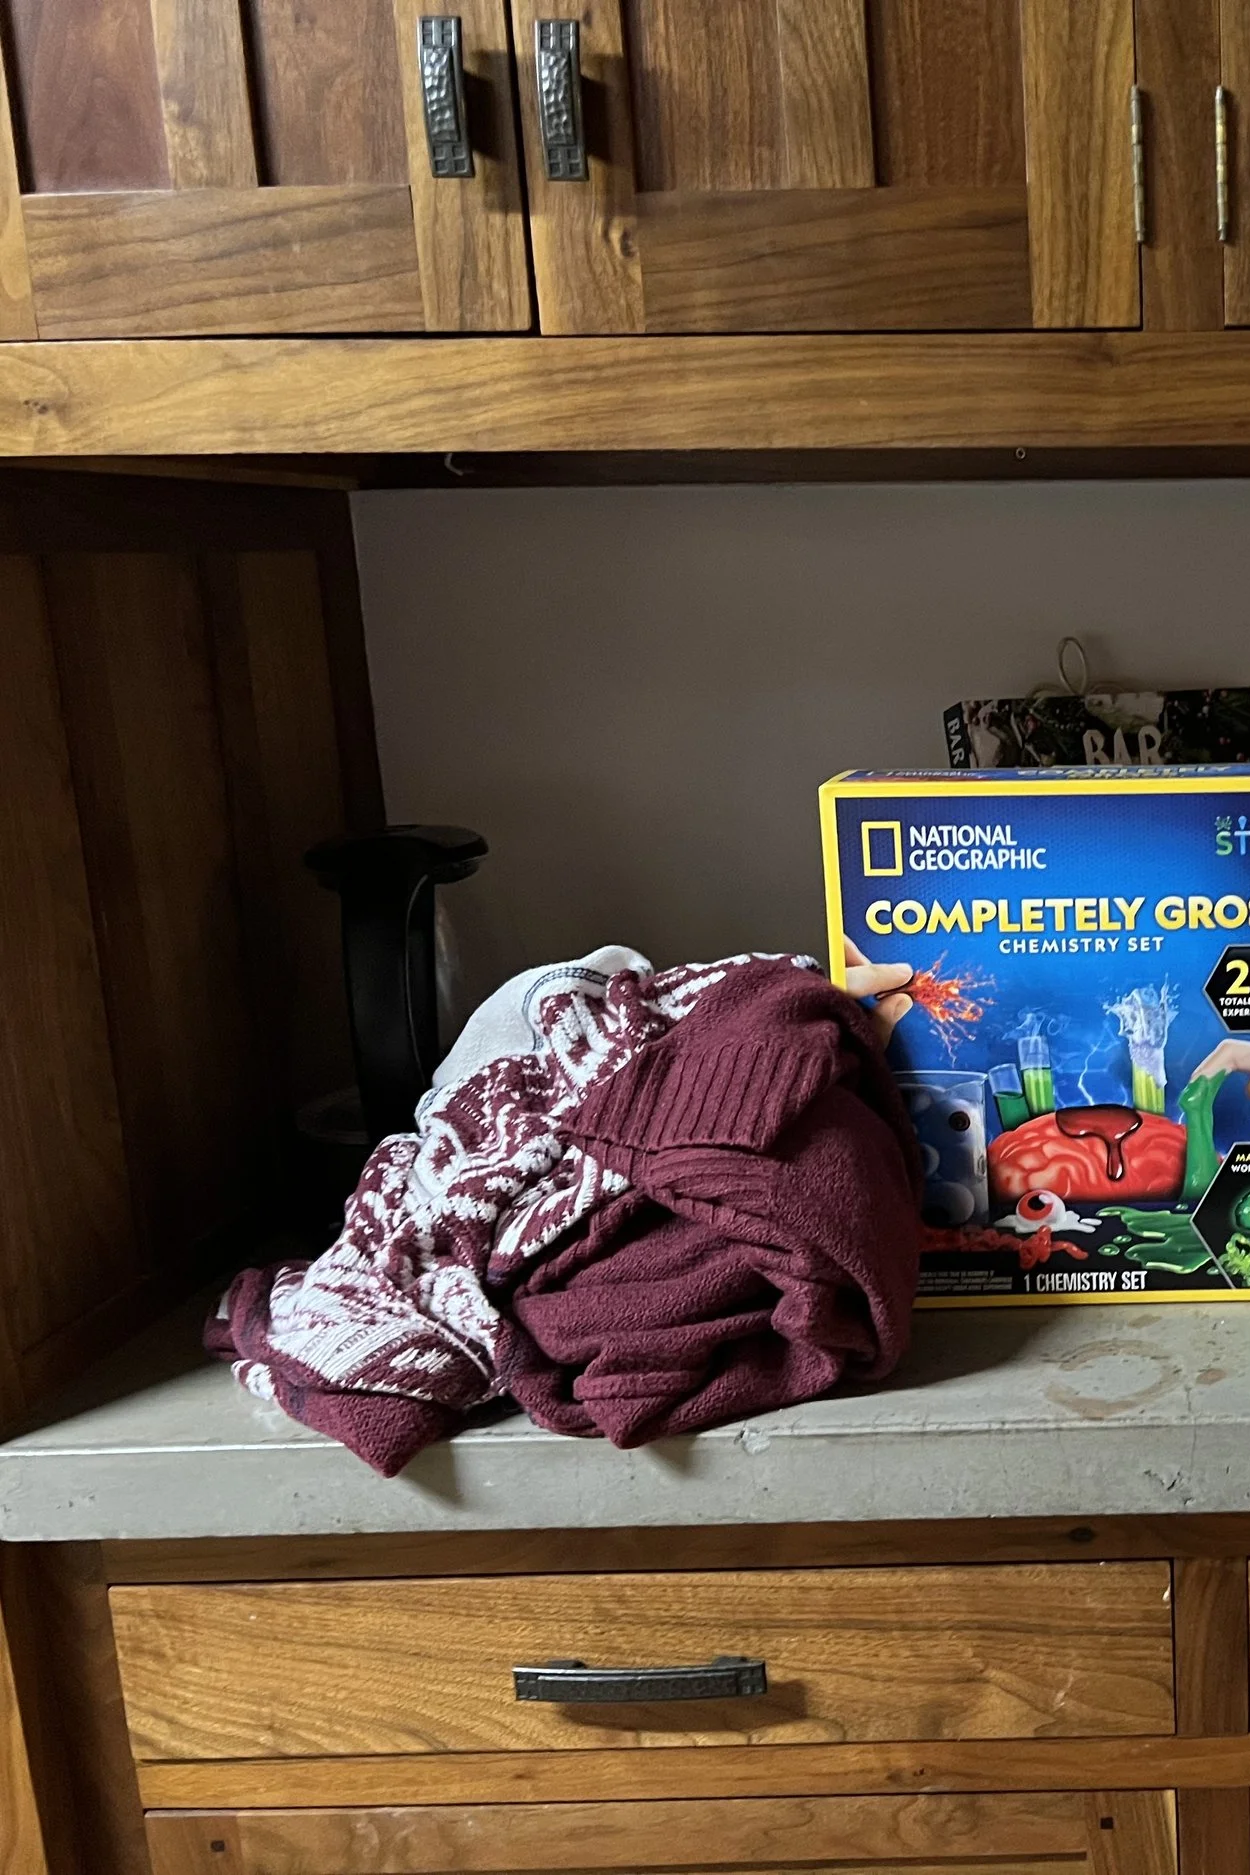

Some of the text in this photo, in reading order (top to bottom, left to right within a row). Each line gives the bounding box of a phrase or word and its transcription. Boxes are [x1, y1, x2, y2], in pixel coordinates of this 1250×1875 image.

[947, 717, 966, 767] BAR
[1082, 724, 1165, 765] BAR
[908, 824, 1018, 848] NATIONAL
[908, 847, 1047, 871] GEOGRAPHIC
[864, 896, 1146, 936] COMPLETELY
[998, 935, 1165, 955] CHEMISTRY SET
[1023, 1270, 1147, 1292] 1 CHEMISTRY SET
